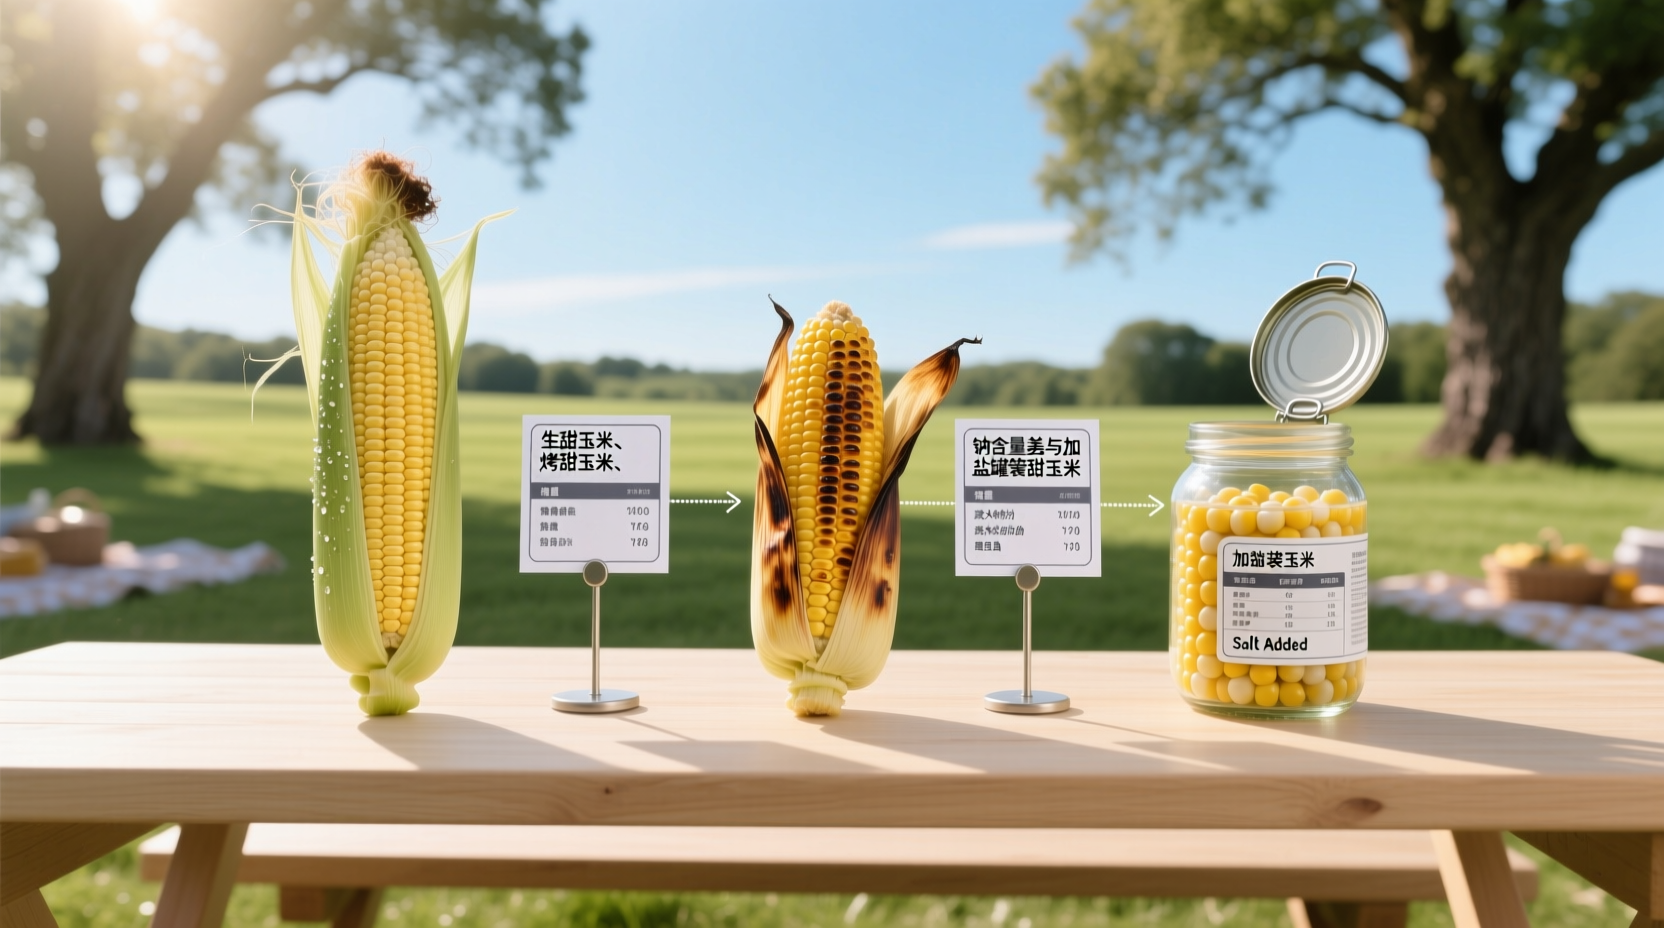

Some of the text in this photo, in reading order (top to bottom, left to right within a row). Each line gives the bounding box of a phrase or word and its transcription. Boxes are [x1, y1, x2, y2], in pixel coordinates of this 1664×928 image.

[541, 430, 622, 449] 生甜玉米、
[539, 451, 621, 472] 烤甜玉米、
[1232, 635, 1308, 651] Salt Added
